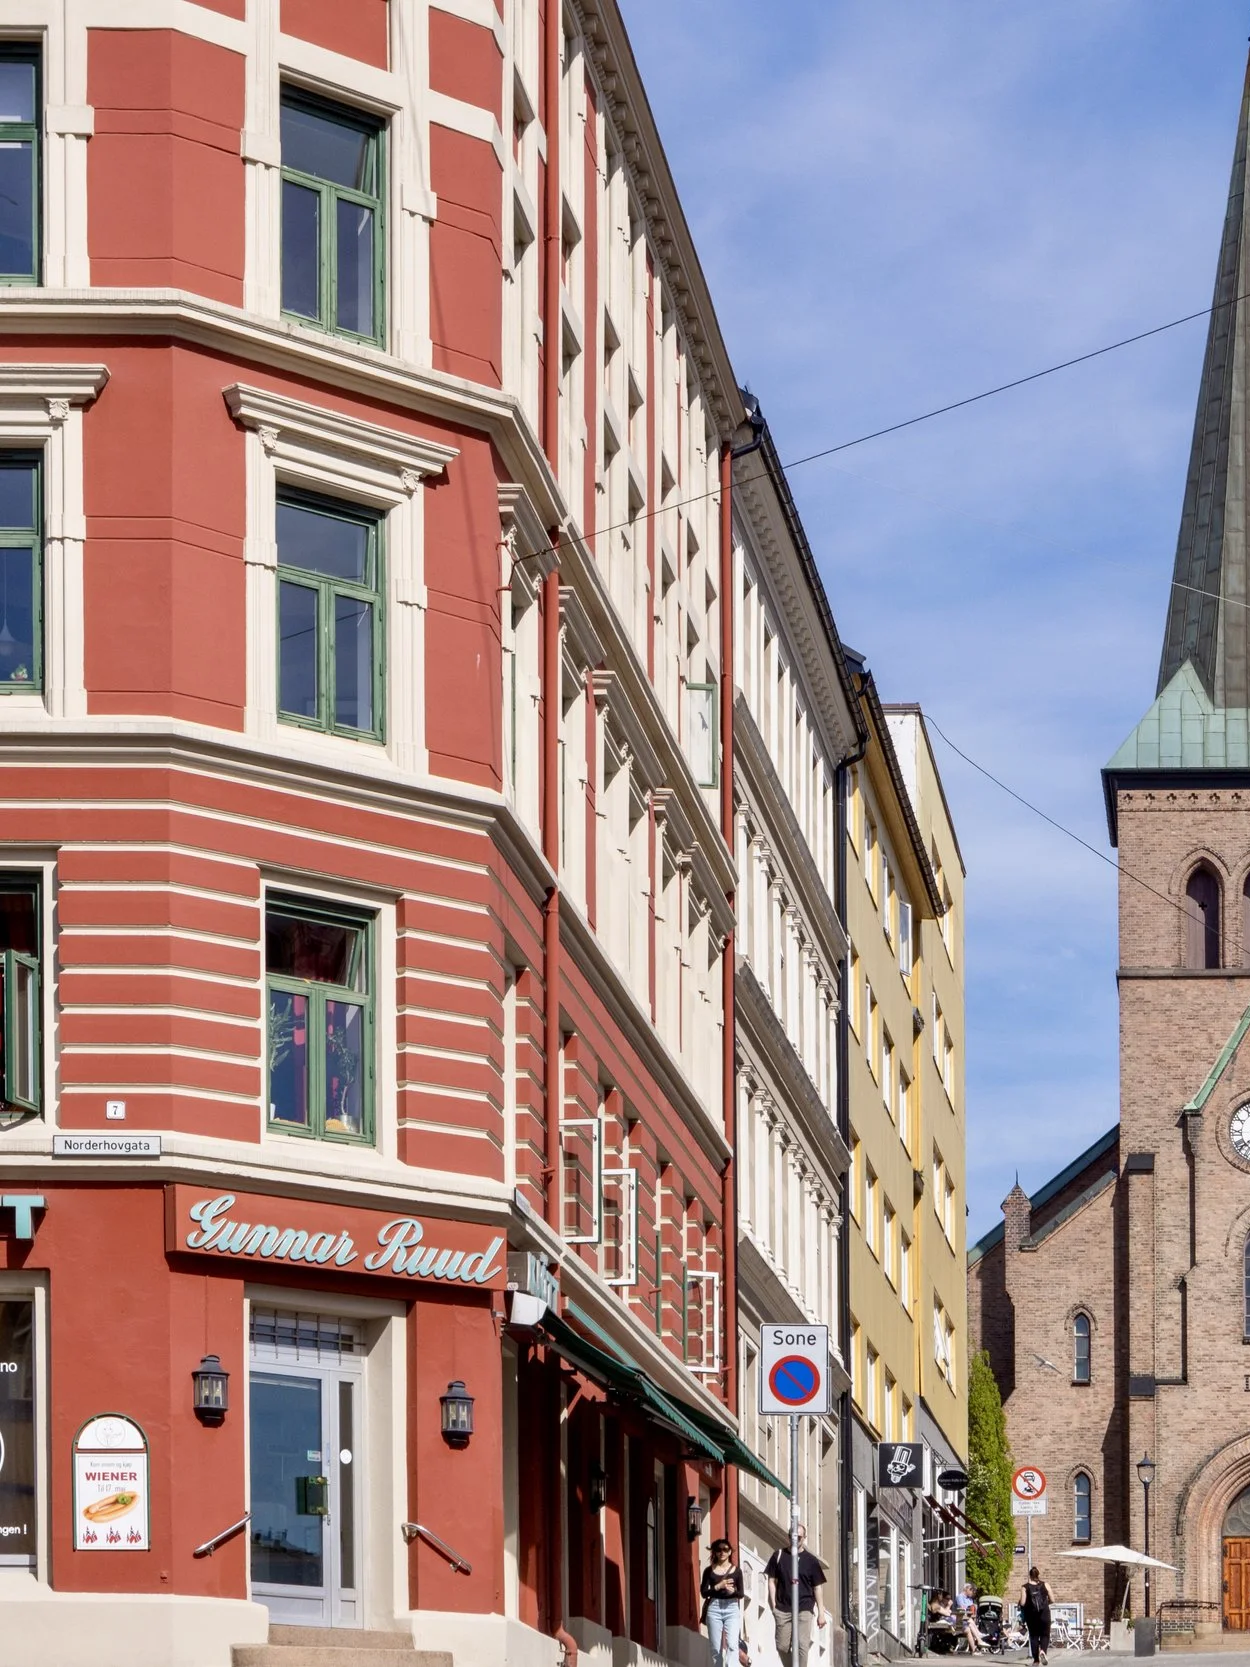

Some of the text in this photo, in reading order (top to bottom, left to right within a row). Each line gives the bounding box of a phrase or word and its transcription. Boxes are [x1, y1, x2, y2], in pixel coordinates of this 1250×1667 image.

[113, 1105, 119, 1115] 7
[64, 1139, 150, 1153] Norderhovgata
[0, 1194, 45, 1239] T
[186, 1194, 358, 1266] Gunnar
[364, 1217, 505, 1284] Ruud
[772, 1329, 817, 1346] Sone
[0, 1361, 18, 1373] no
[85, 1472, 138, 1481] WIENER
